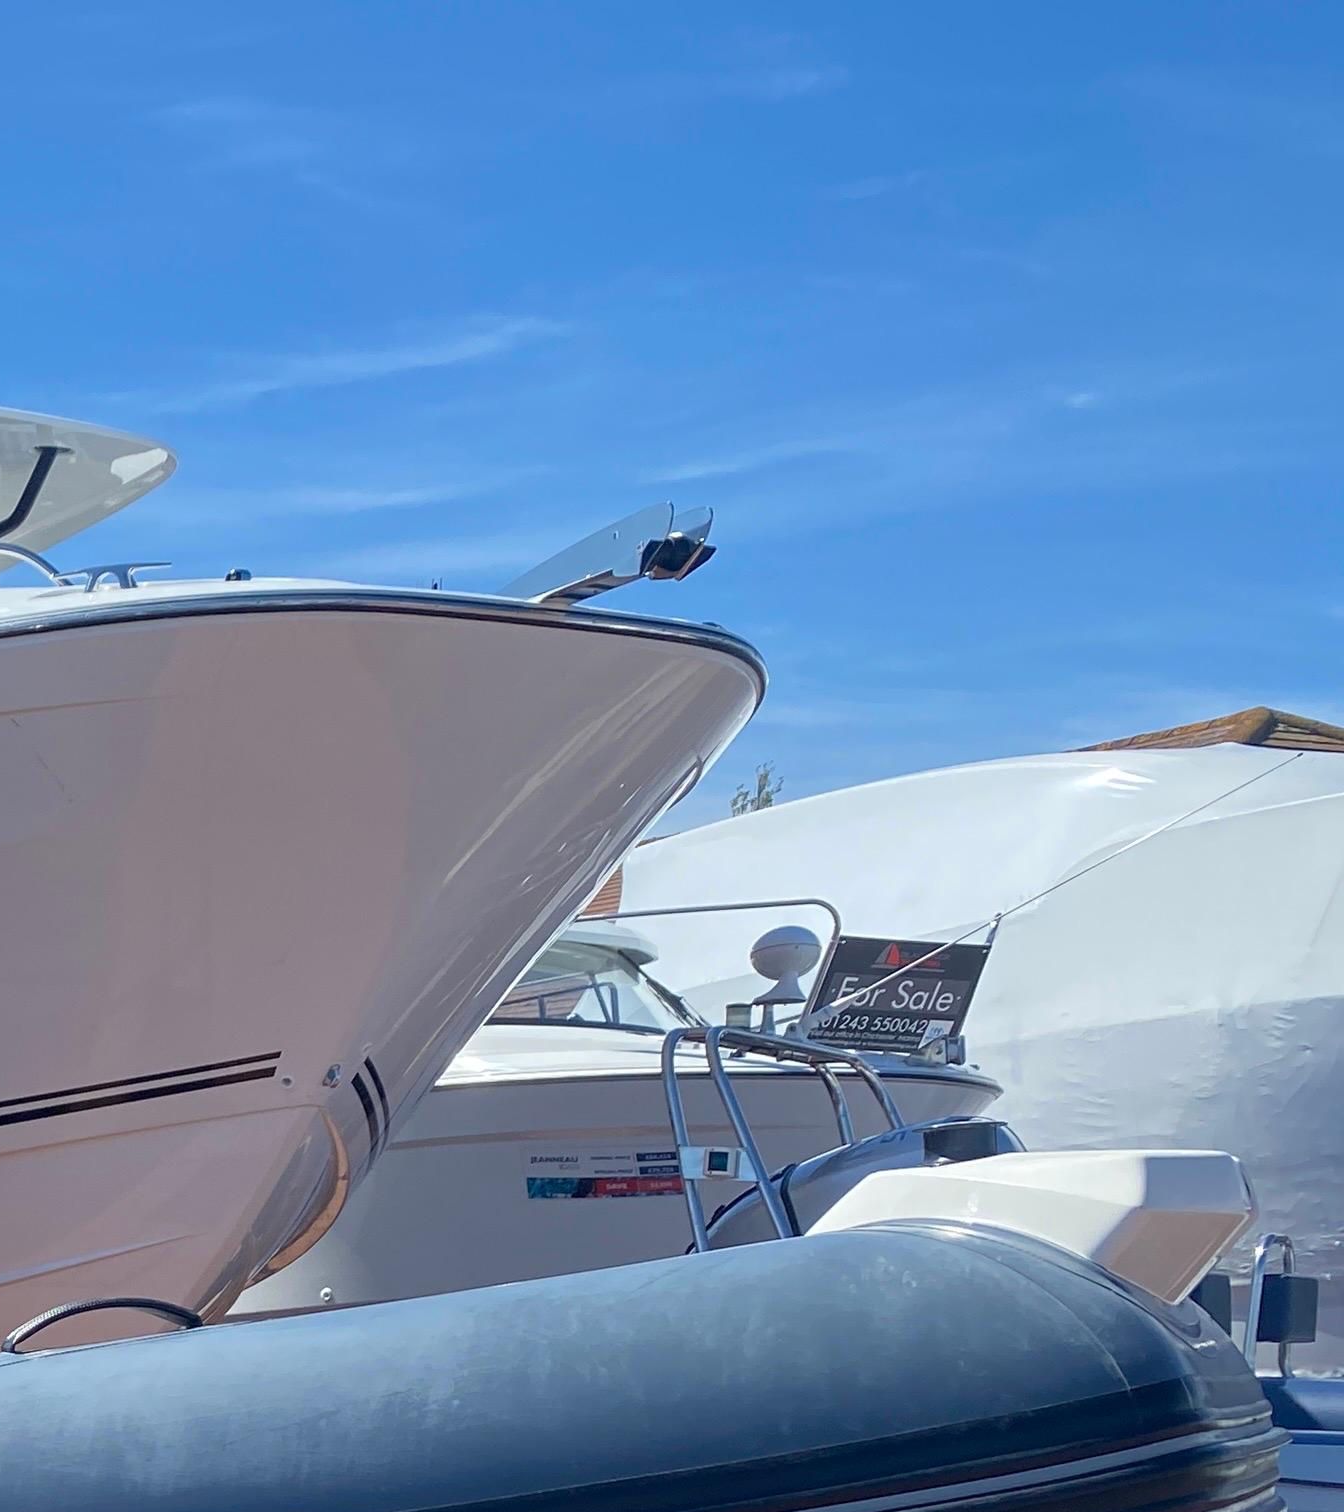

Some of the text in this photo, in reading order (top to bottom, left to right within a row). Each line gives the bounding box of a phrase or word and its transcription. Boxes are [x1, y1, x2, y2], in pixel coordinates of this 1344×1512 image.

[836, 976, 954, 1012] For Sale
[870, 1018, 928, 1034] 550042
